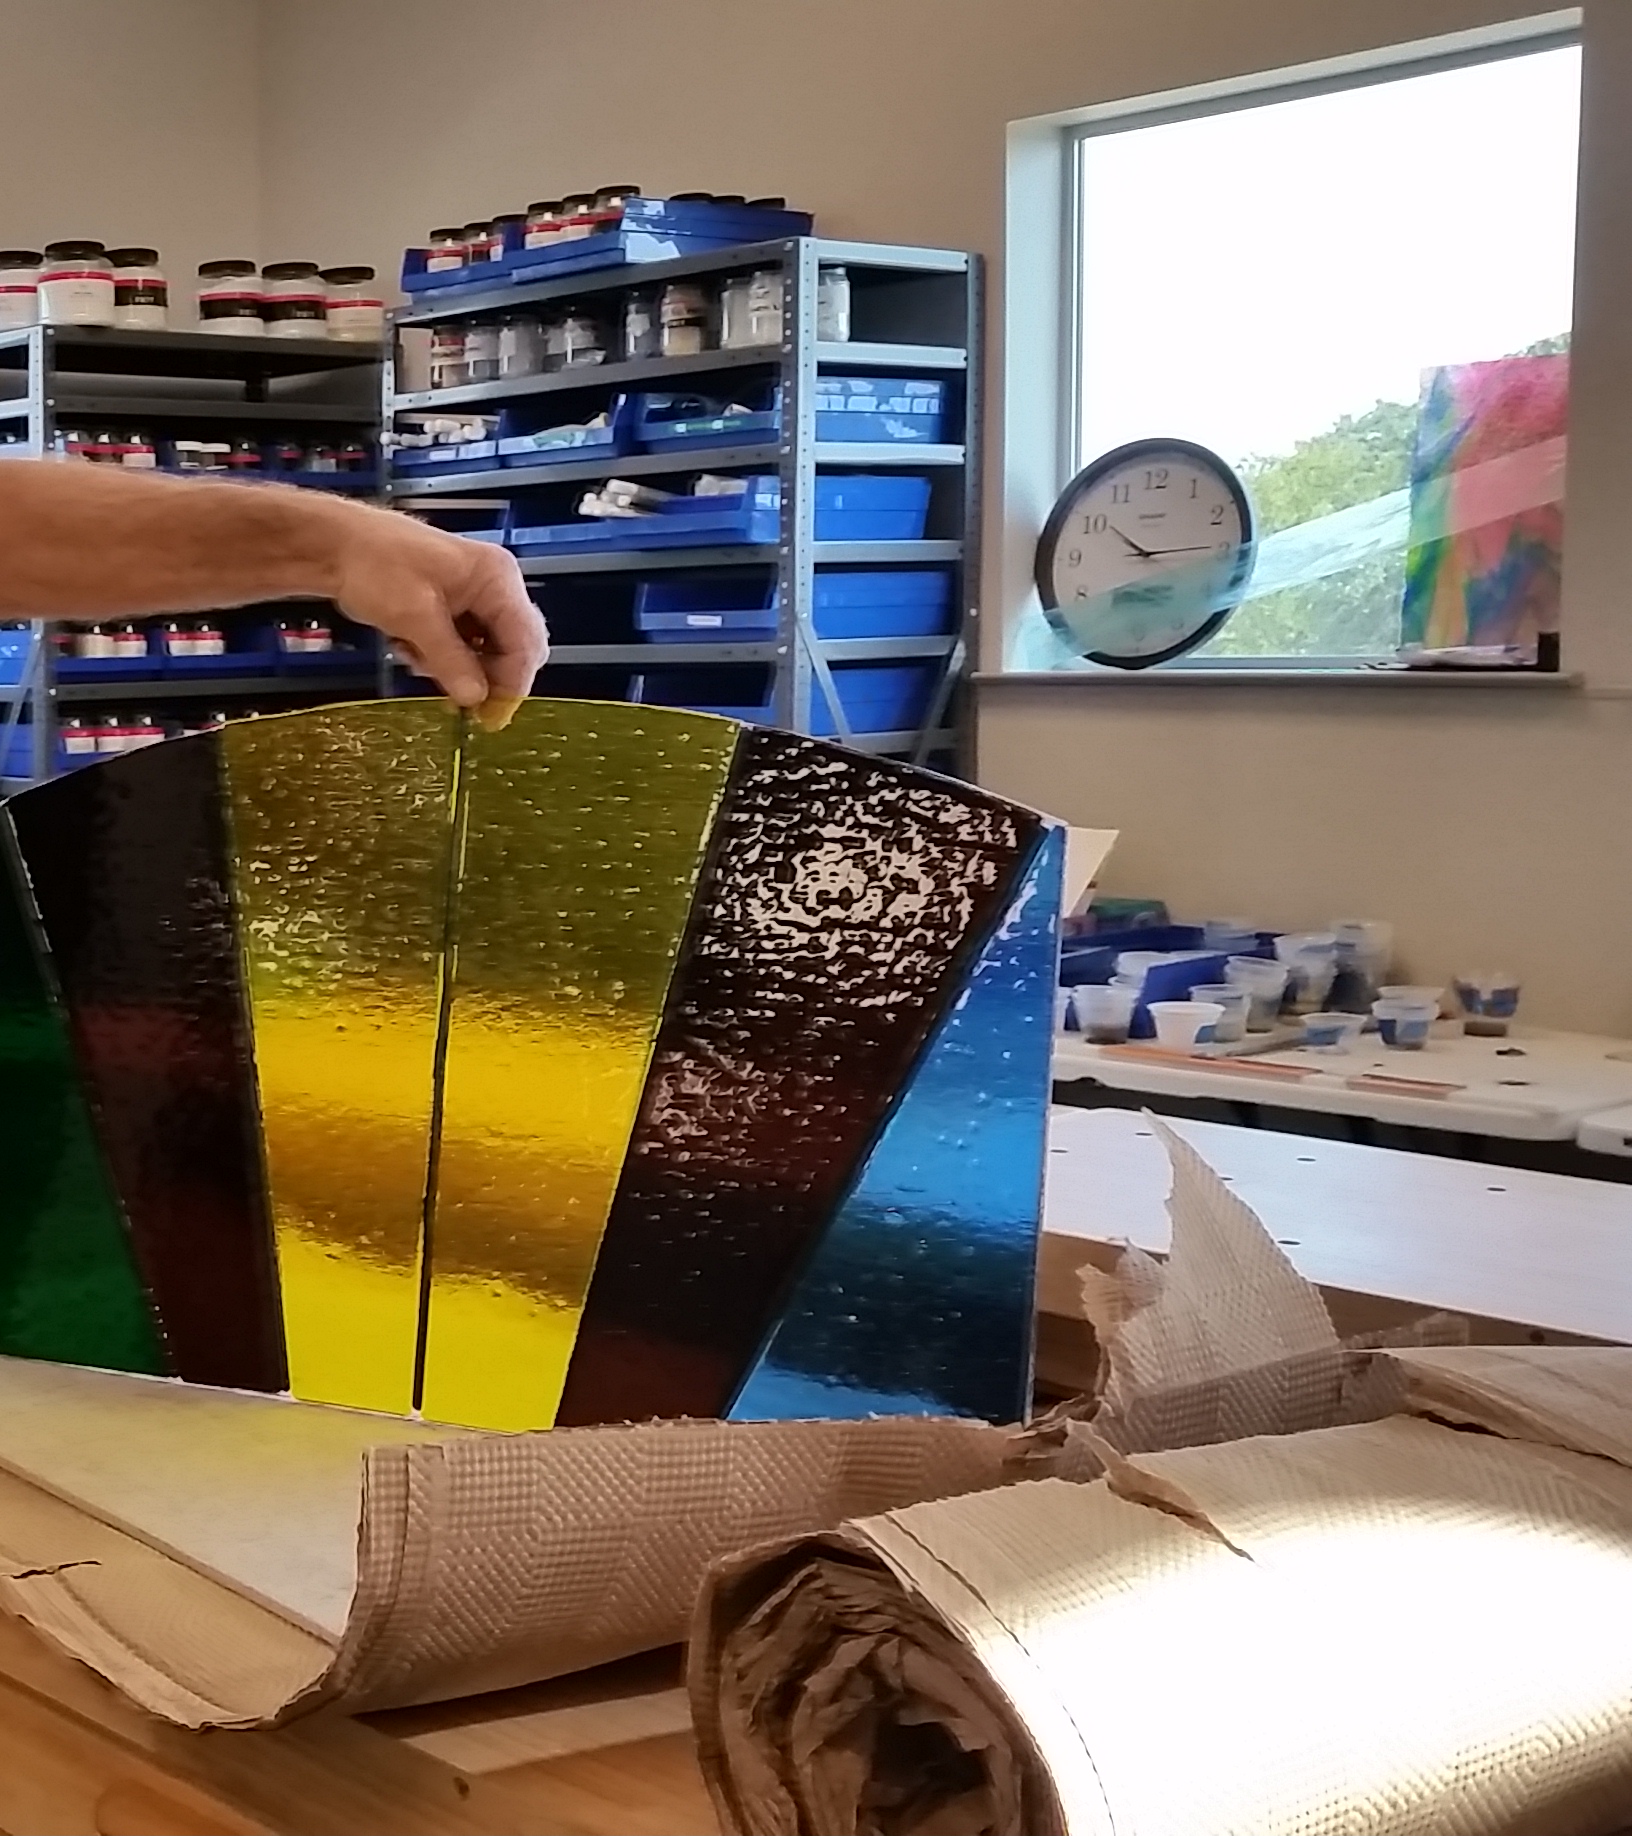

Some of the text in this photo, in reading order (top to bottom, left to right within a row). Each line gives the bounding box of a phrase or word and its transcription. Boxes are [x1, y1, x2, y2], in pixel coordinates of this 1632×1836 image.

[1144, 468, 1168, 490] 12
[1189, 478, 1197, 499] 1
[1112, 484, 1130, 504] 11
[1083, 513, 1107, 535] 10
[1210, 505, 1224, 526] 2
[1069, 549, 1082, 568] 9
